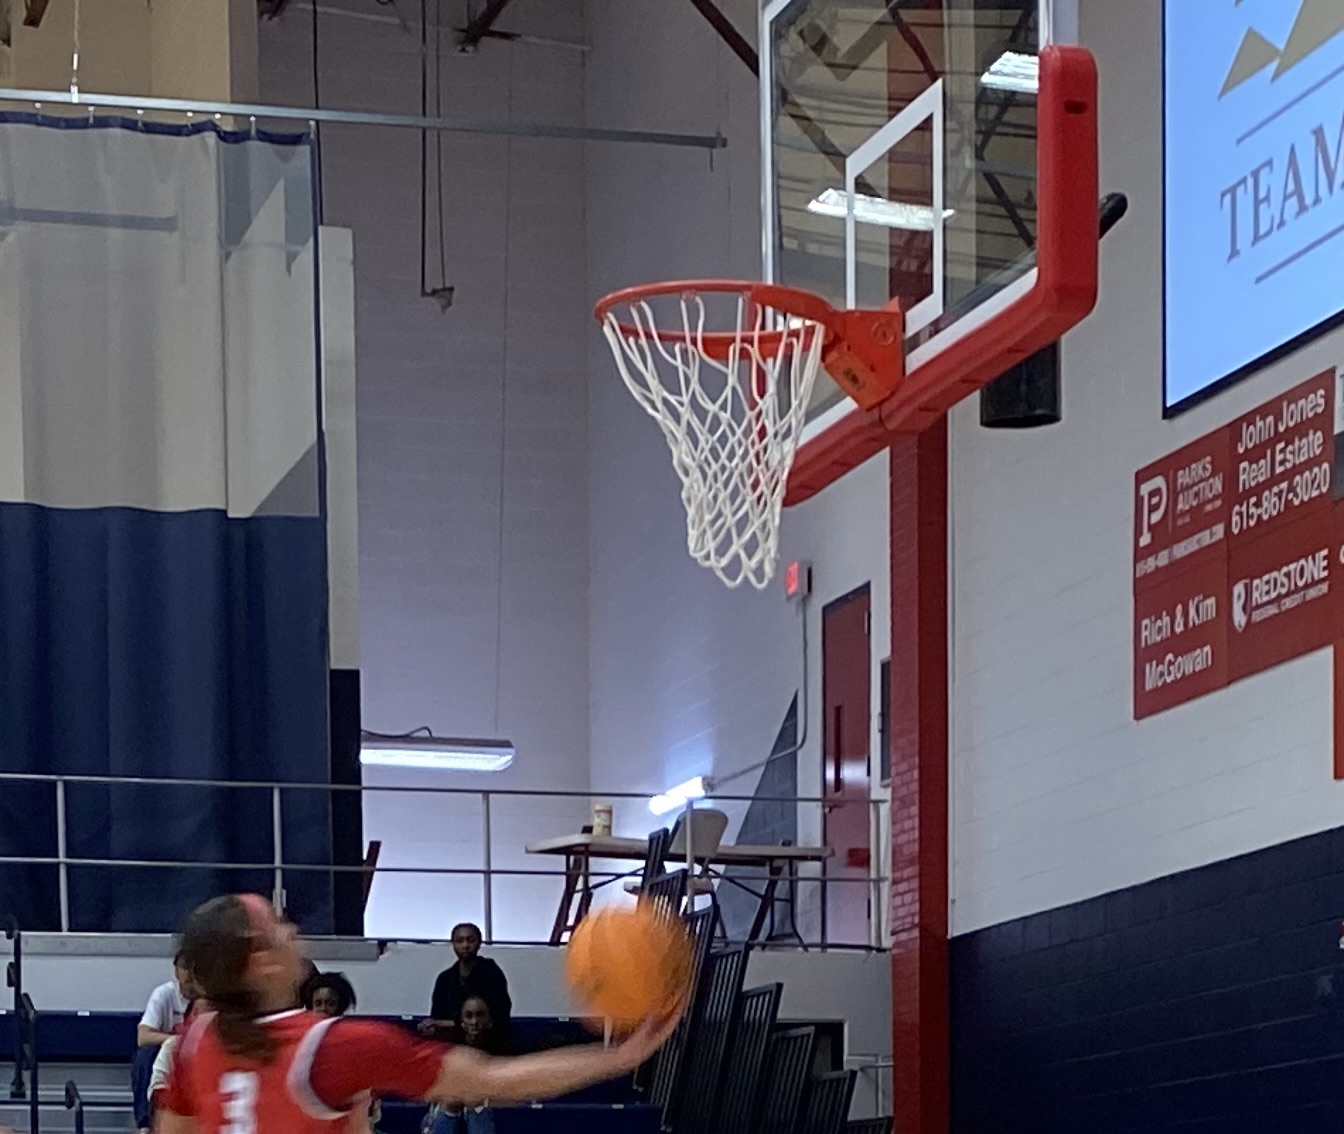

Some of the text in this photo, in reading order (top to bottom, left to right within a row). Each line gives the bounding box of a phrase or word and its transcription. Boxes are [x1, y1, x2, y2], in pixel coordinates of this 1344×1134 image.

[1237, 409, 1275, 454] John
[1278, 388, 1326, 442] Jones
[1177, 456, 1212, 491] PARKS
[1238, 456, 1271, 493] Real
[1275, 430, 1323, 483] Estate
[1177, 472, 1223, 513] AUCTION
[1231, 462, 1331, 536] 615-867-3020
[1251, 547, 1329, 608] REDSTONE
[1140, 593, 1217, 648] Rich & Kim
[1145, 643, 1212, 692] McGowan
